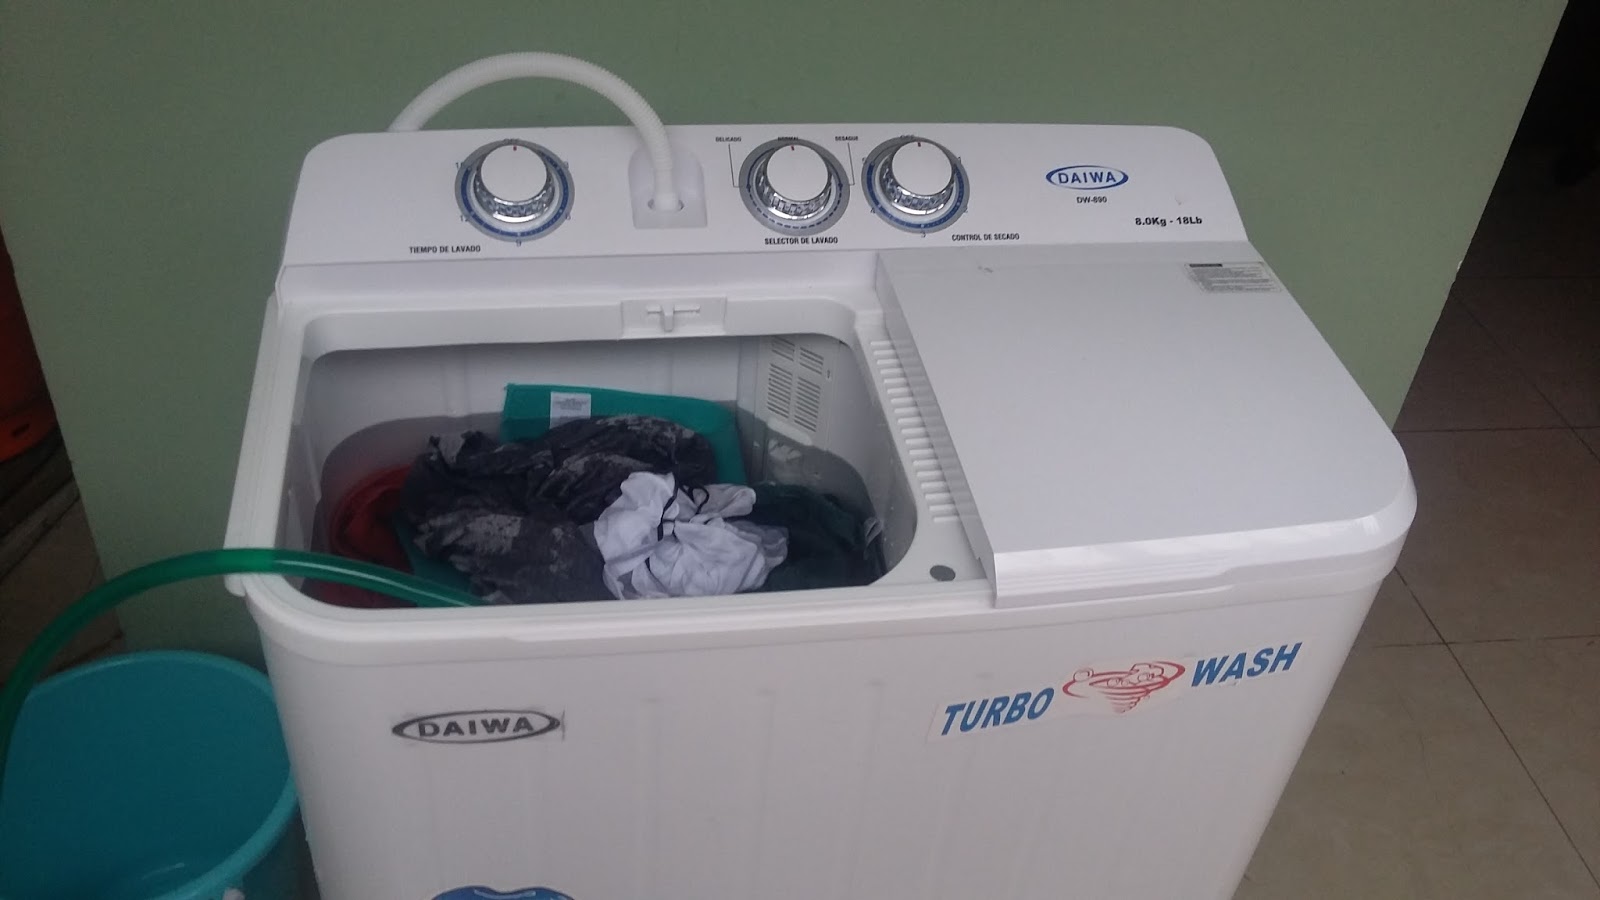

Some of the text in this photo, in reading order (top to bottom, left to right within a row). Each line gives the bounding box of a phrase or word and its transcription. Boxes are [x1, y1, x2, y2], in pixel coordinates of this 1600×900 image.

[1057, 171, 1117, 184] DAIWA
[1135, 217, 1167, 227] 8.0Kg
[1176, 216, 1203, 225] 18Lb
[983, 233, 993, 241] DE
[993, 233, 1020, 241] SECADO
[409, 246, 438, 254] TIEMPO
[941, 642, 1303, 735] TURBO WASH
[418, 717, 534, 737] DAIWA
